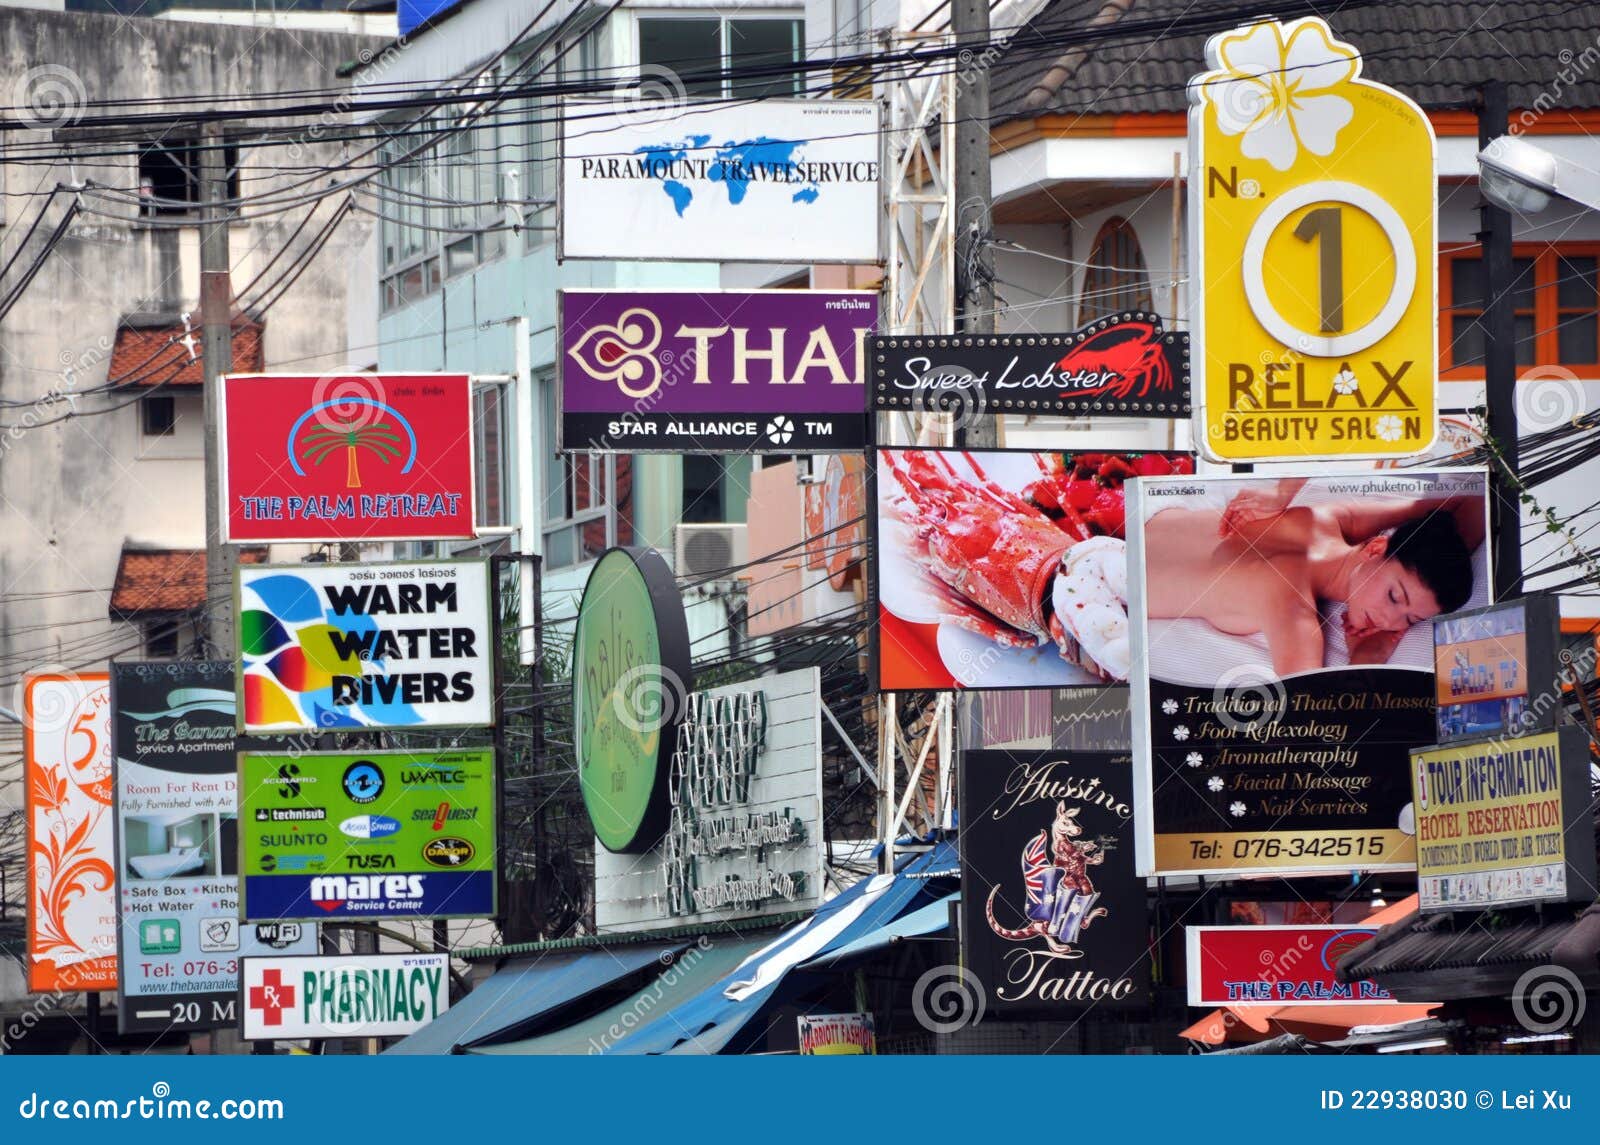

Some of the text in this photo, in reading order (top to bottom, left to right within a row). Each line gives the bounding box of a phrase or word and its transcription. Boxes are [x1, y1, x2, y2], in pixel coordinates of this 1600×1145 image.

[581, 157, 710, 180] PARAMOUNT
[1292, 207, 1344, 333] 1
[825, 298, 871, 310] การบินไทย
[674, 324, 866, 385] THAI
[894, 355, 1119, 390] Sweet Lobster
[1228, 361, 1416, 410] RELAX
[608, 421, 833, 436] STAR ALLIANCE TM
[1225, 417, 1319, 441] BEAUTY
[1328, 480, 1480, 496] www.phuketno1relax.com
[239, 491, 462, 520] THE PALM RETREAT
[324, 582, 458, 616] WARM
[328, 627, 478, 662] WATER
[331, 671, 475, 707] DIVERS
[1184, 694, 1286, 715] Traditional
[71, 711, 97, 771] 5
[135, 723, 170, 742] The
[1194, 720, 1348, 744] Foot Reflexology
[136, 742, 235, 755] Service Apartment
[1206, 747, 1359, 769] Aromatheraphy
[1228, 772, 1372, 794] Facial Massage
[1428, 759, 1465, 806] TOUR
[1465, 745, 1558, 801] INFORMATION
[126, 781, 237, 794] Room For Rent D
[121, 797, 232, 813] Fully Furnished with Air
[272, 808, 325, 820] technisub
[1252, 798, 1368, 817] Nail Services
[1418, 800, 1561, 841] HOTEL RESERVATION
[260, 834, 328, 848] SUUNTO
[1190, 837, 1385, 860] Tel: 076-342515
[1521, 835, 1534, 857] AIR
[346, 854, 396, 869] TUSA
[131, 886, 159, 898] Safe
[164, 886, 187, 896] Box
[310, 874, 425, 901] mares
[132, 903, 154, 913] Hot
[158, 901, 194, 912] Water
[346, 900, 423, 912] Service Center
[140, 960, 238, 978] Tel: 076-3
[997, 947, 1137, 1002] Tattoo
[303, 967, 442, 1025] PHARMACY
[1224, 981, 1272, 1000] THE
[1277, 981, 1351, 1001] PALM
[172, 1002, 200, 1023] 20
